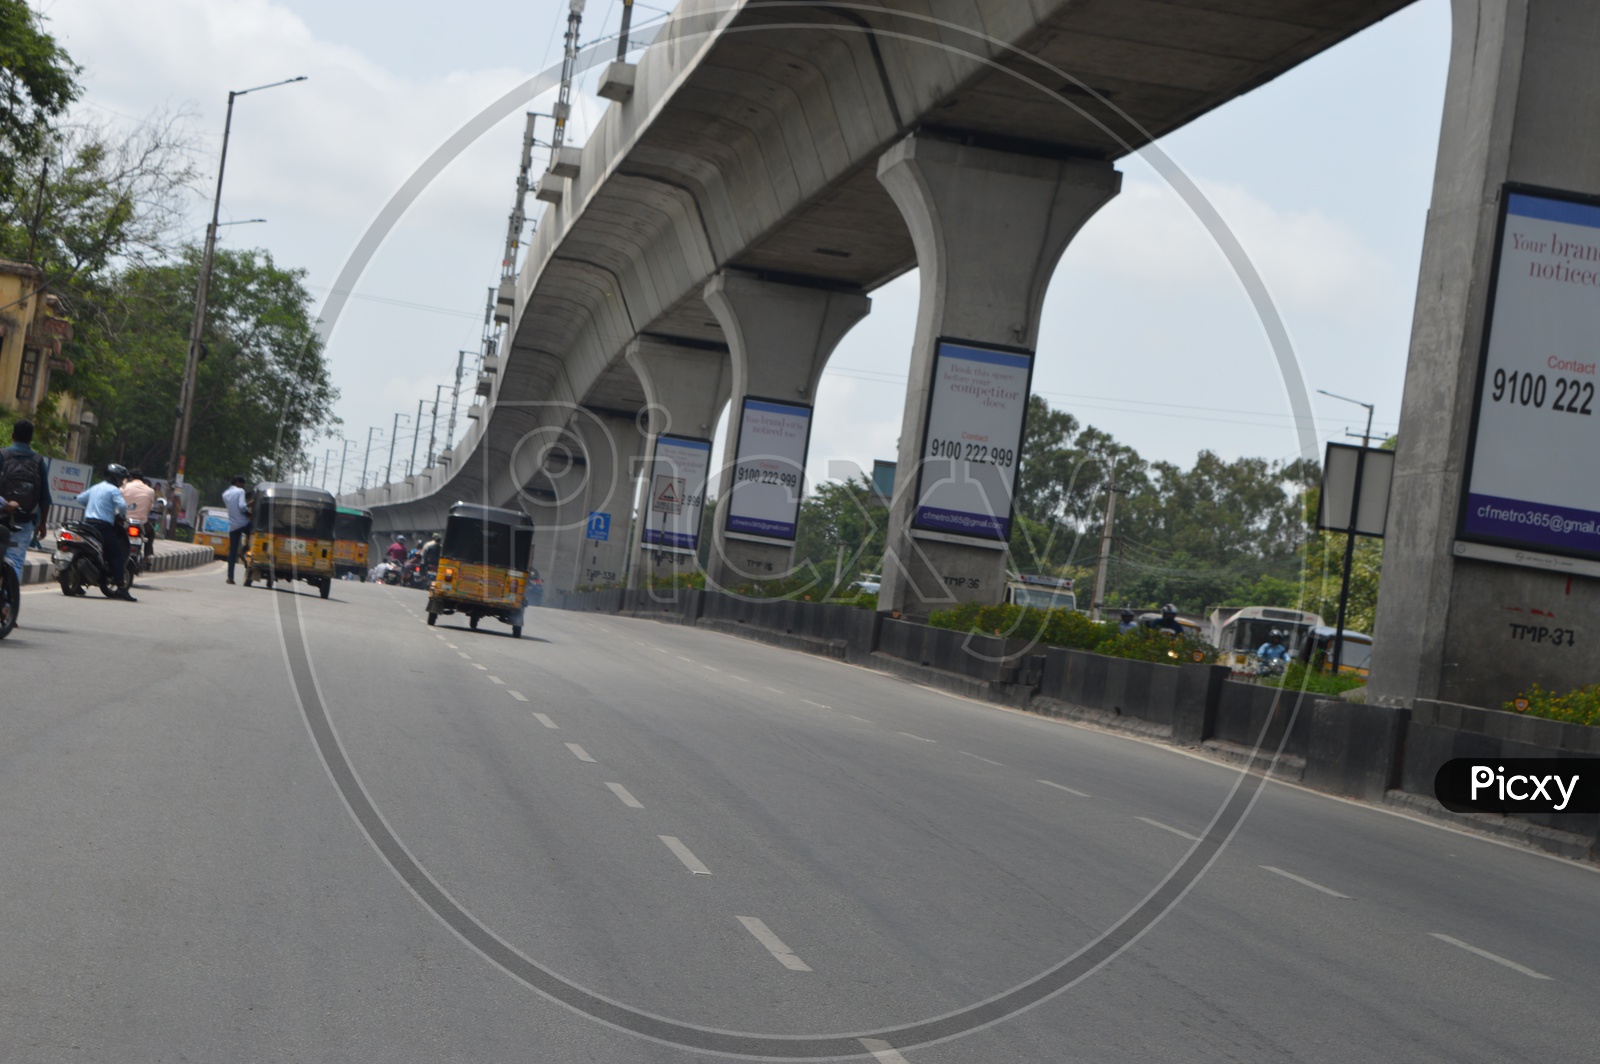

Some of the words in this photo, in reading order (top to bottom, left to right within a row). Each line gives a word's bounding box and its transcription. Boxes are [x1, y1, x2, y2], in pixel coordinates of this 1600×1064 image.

[1512, 233, 1548, 254] Your
[1551, 232, 1600, 262] bran
[950, 363, 972, 375] Book
[974, 367, 990, 377] this
[1547, 355, 1596, 375] Contact
[943, 371, 970, 383] before
[971, 377, 991, 387] your
[950, 382, 1020, 401] competitor
[1492, 368, 1547, 408] 9100
[1552, 377, 1595, 416] 222
[982, 397, 1006, 409] does
[761, 415, 786, 427] brand
[752, 425, 783, 437] noticed
[961, 431, 989, 443] Contact
[931, 438, 962, 461] 9100
[965, 443, 988, 464] 222
[990, 447, 1014, 468] 999
[738, 466, 760, 483] 9100
[761, 470, 779, 485] 222
[780, 473, 797, 488] 999
[922, 511, 1004, 530] cfmetro365@gmail.com
[1509, 622, 1575, 647] TMP-37
